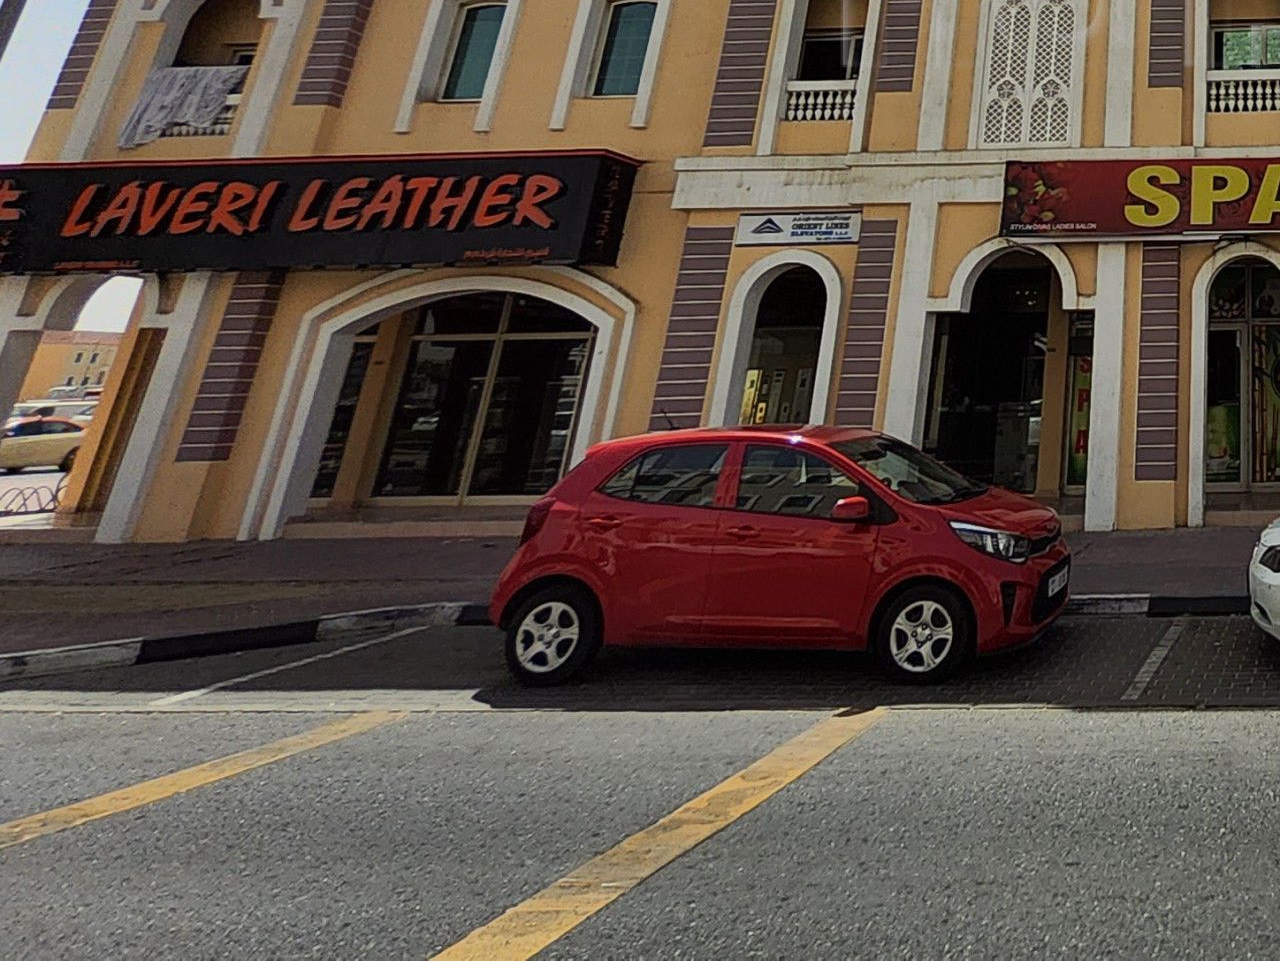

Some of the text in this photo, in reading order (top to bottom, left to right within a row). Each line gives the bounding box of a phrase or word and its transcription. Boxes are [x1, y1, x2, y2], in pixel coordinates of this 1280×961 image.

[61, 180, 274, 237] LAVERI
[288, 174, 564, 232] LEATHER
[1074, 356, 1092, 455] SPA
